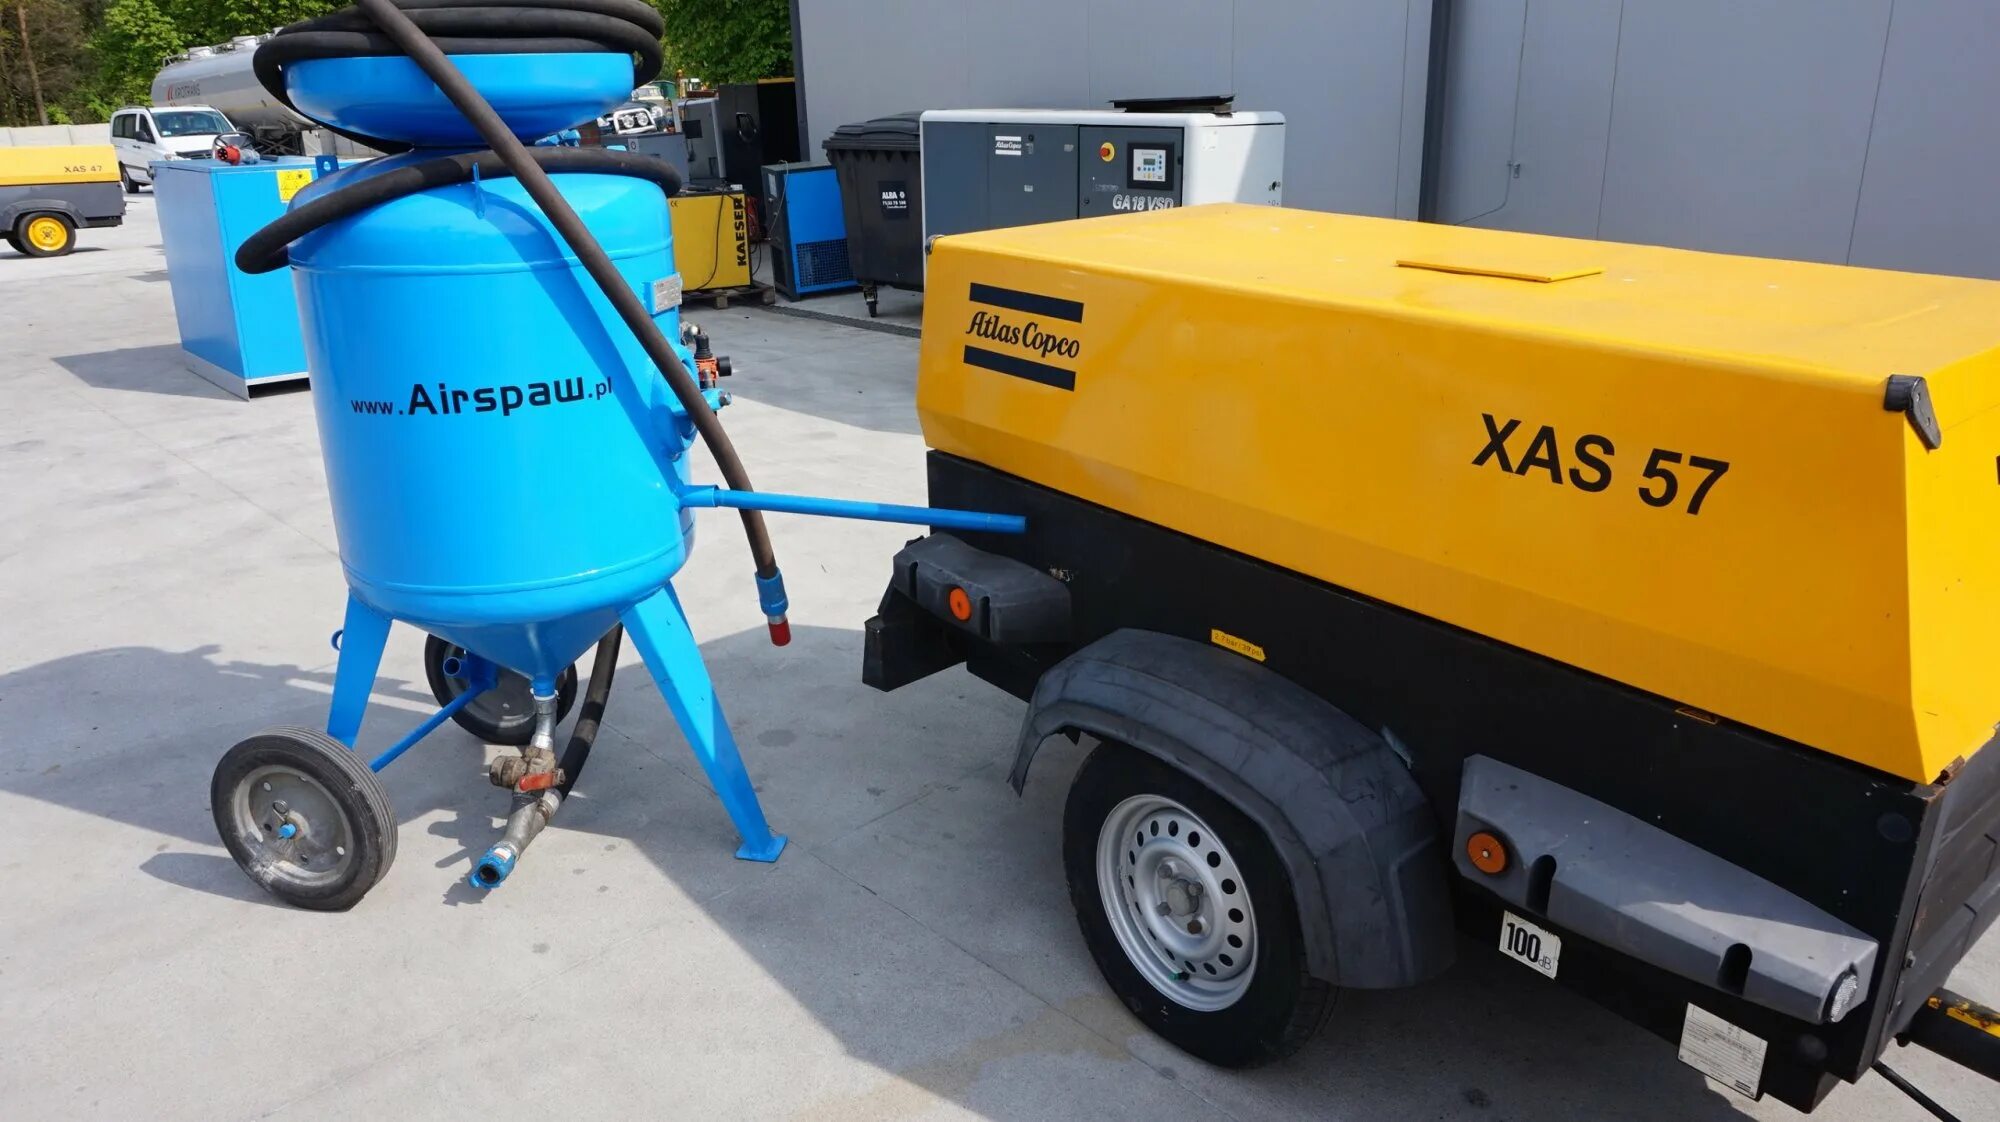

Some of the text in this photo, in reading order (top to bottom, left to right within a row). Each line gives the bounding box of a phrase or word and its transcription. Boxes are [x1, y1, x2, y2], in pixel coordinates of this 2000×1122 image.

[64, 165, 87, 173] XAS
[1112, 193, 1131, 210] GA
[1131, 195, 1145, 211] 18
[733, 197, 747, 267] KAESER
[965, 310, 1080, 358] Atlas Copco
[1471, 413, 1730, 516] XAS 57
[1506, 922, 1541, 963] 100
[1538, 956, 1552, 970] dB
